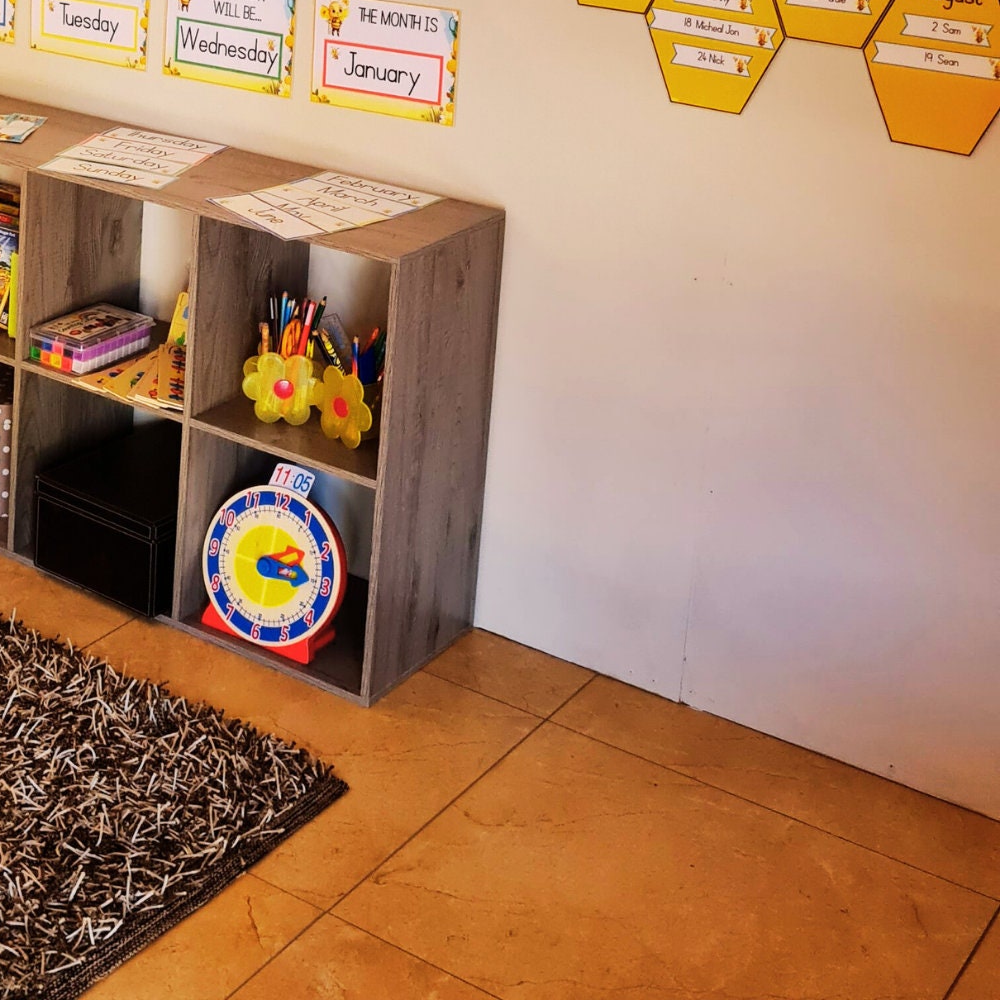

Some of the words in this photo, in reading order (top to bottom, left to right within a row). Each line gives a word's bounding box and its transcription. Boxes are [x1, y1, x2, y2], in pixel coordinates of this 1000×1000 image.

[214, 0, 240, 19] WILL
[59, 2, 119, 42] Tuesday
[358, 7, 378, 23] THE
[380, 12, 421, 31] MONTH
[424, 18, 438, 32] IS
[932, 22, 939, 32] 2
[943, 24, 961, 35] Sam
[180, 25, 278, 74] Wednesday
[344, 51, 420, 96] January
[127, 130, 207, 151] Thursday
[113, 142, 176, 158] Friday
[80, 149, 169, 170] Saturday
[73, 163, 144, 182] Sunday
[318, 185, 378, 207] March
[327, 176, 422, 201] February
[274, 466, 310, 492] 11:05
[246, 491, 260, 508] 11
[275, 493, 290, 510] 12
[220, 508, 234, 527] 10
[305, 511, 311, 526] 1
[210, 540, 219, 555] 9
[321, 544, 329, 560] 2
[211, 576, 220, 591] 8
[321, 580, 330, 595] 3
[226, 605, 234, 620] 7
[304, 610, 314, 626] 4
[251, 624, 260, 639] 6
[280, 626, 289, 641] 5
